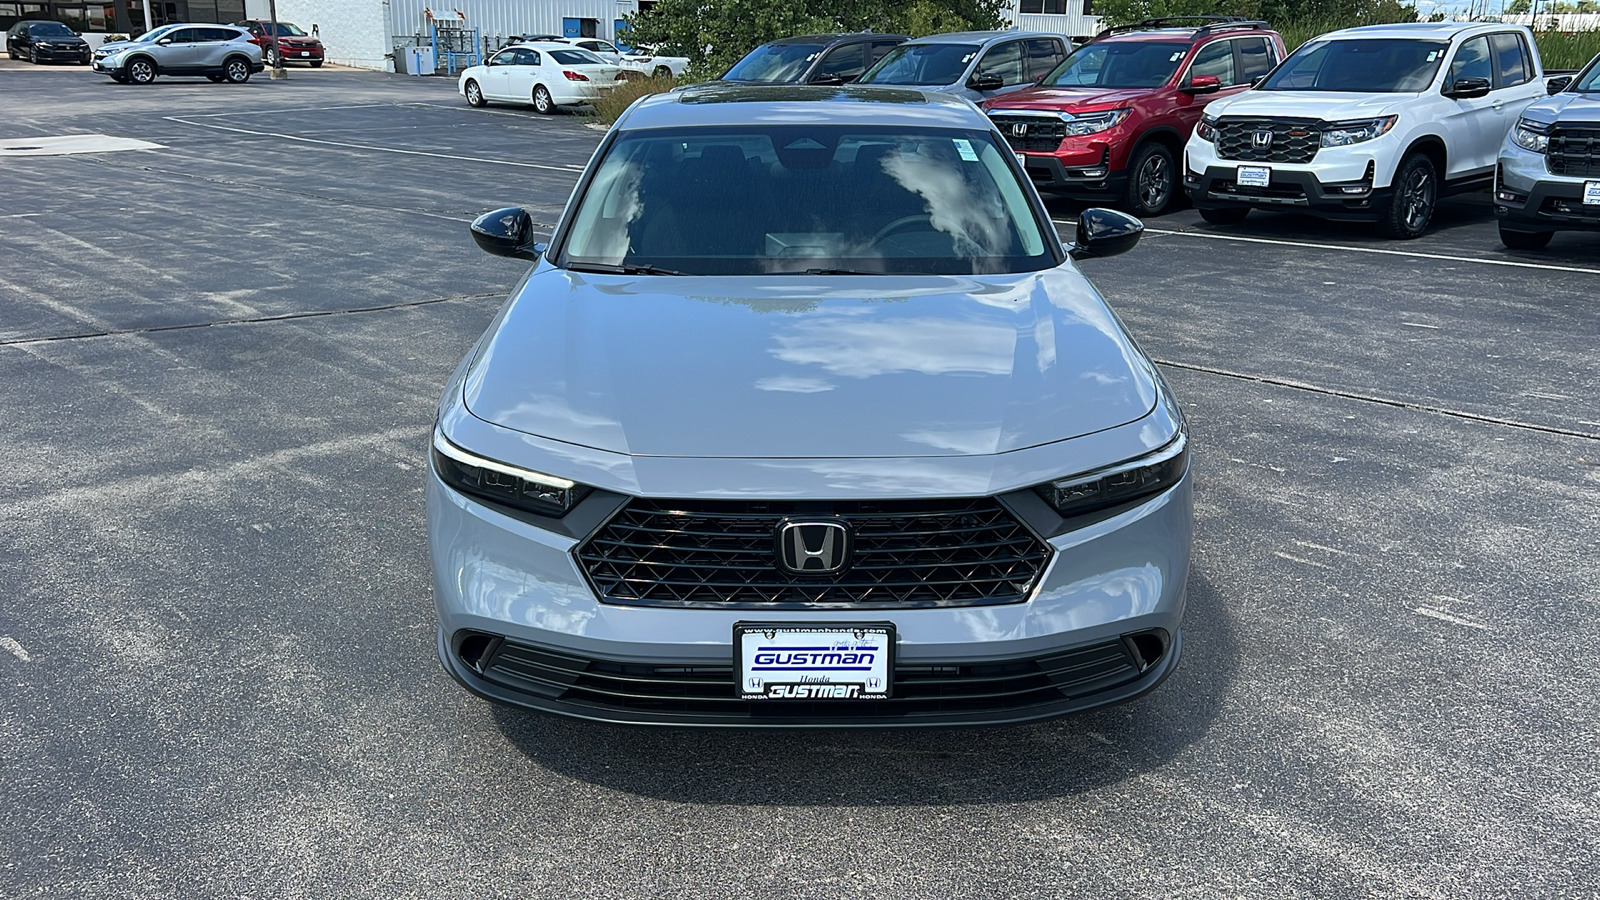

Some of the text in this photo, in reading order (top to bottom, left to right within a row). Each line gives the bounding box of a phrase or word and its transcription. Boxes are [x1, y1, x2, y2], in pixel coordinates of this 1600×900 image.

[754, 653, 875, 665] GUSTMAN
[799, 675, 830, 683] Honda
[768, 685, 860, 698] GUSTMAN
